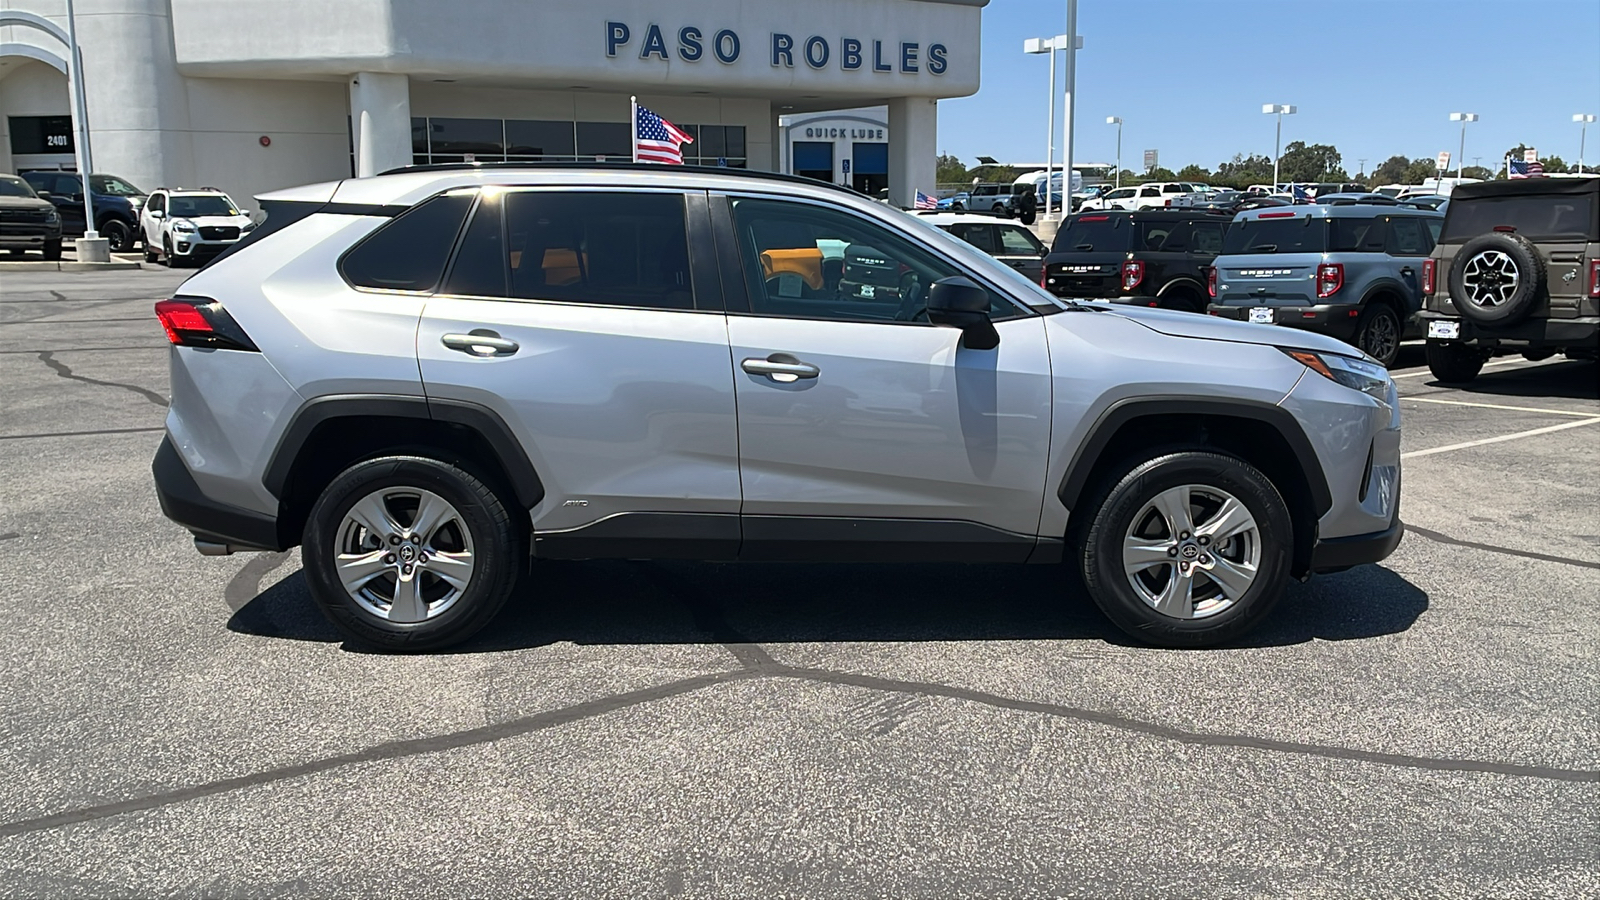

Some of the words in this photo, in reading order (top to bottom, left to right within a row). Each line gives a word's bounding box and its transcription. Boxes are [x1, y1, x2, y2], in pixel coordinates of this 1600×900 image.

[606, 21, 741, 65] PASO
[771, 32, 948, 76] ROBLES
[806, 128, 846, 138] QUICK
[851, 128, 883, 139] LUBE
[47, 135, 68, 146] 2401
